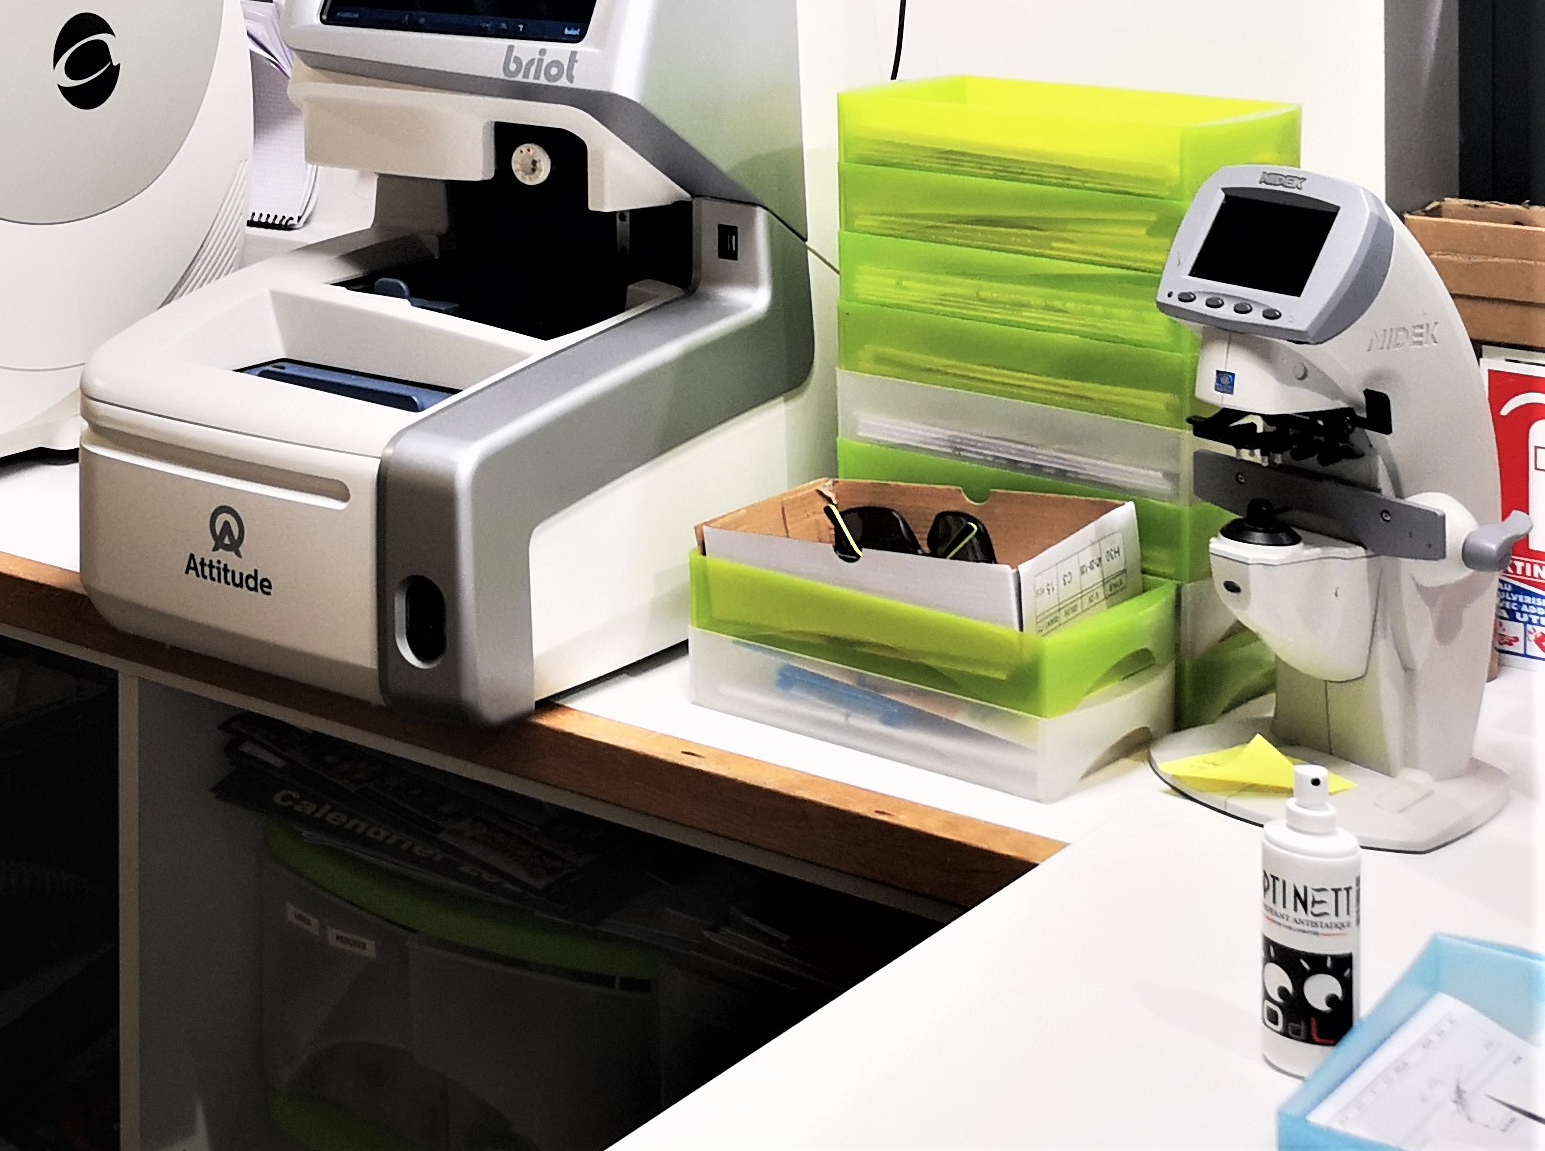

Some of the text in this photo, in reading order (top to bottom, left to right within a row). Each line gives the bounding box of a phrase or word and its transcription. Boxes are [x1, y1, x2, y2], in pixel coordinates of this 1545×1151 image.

[502, 44, 579, 84] briot
[1259, 171, 1307, 191] NIDEK
[1366, 321, 1439, 352] NIDEK
[184, 553, 273, 596] Attitude
